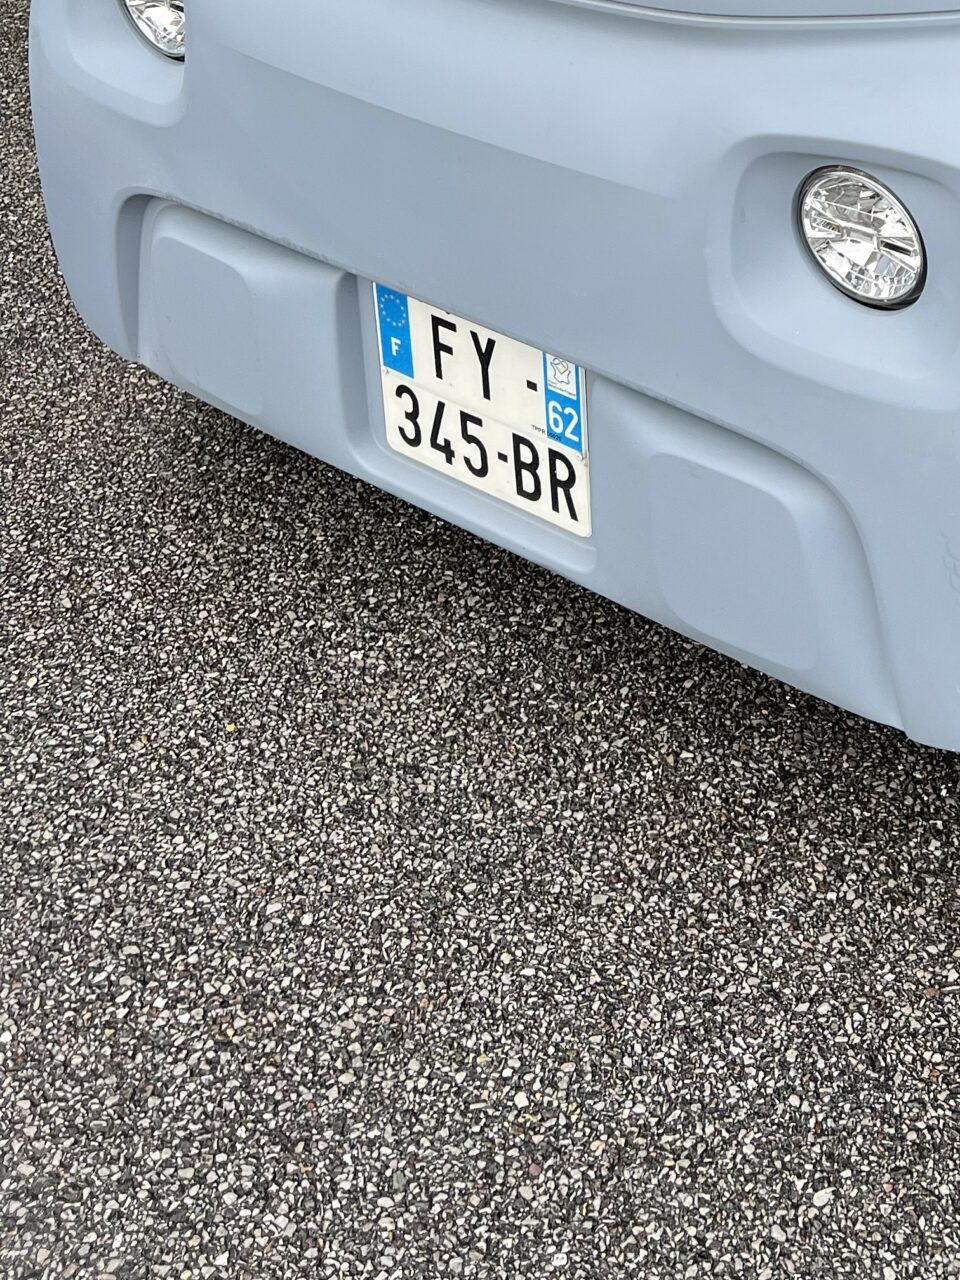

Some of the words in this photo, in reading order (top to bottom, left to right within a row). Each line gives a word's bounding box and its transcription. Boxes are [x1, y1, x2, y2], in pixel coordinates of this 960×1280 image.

[390, 336, 402, 357] F
[548, 400, 580, 442] 62
[395, 384, 579, 522] 345-BR
